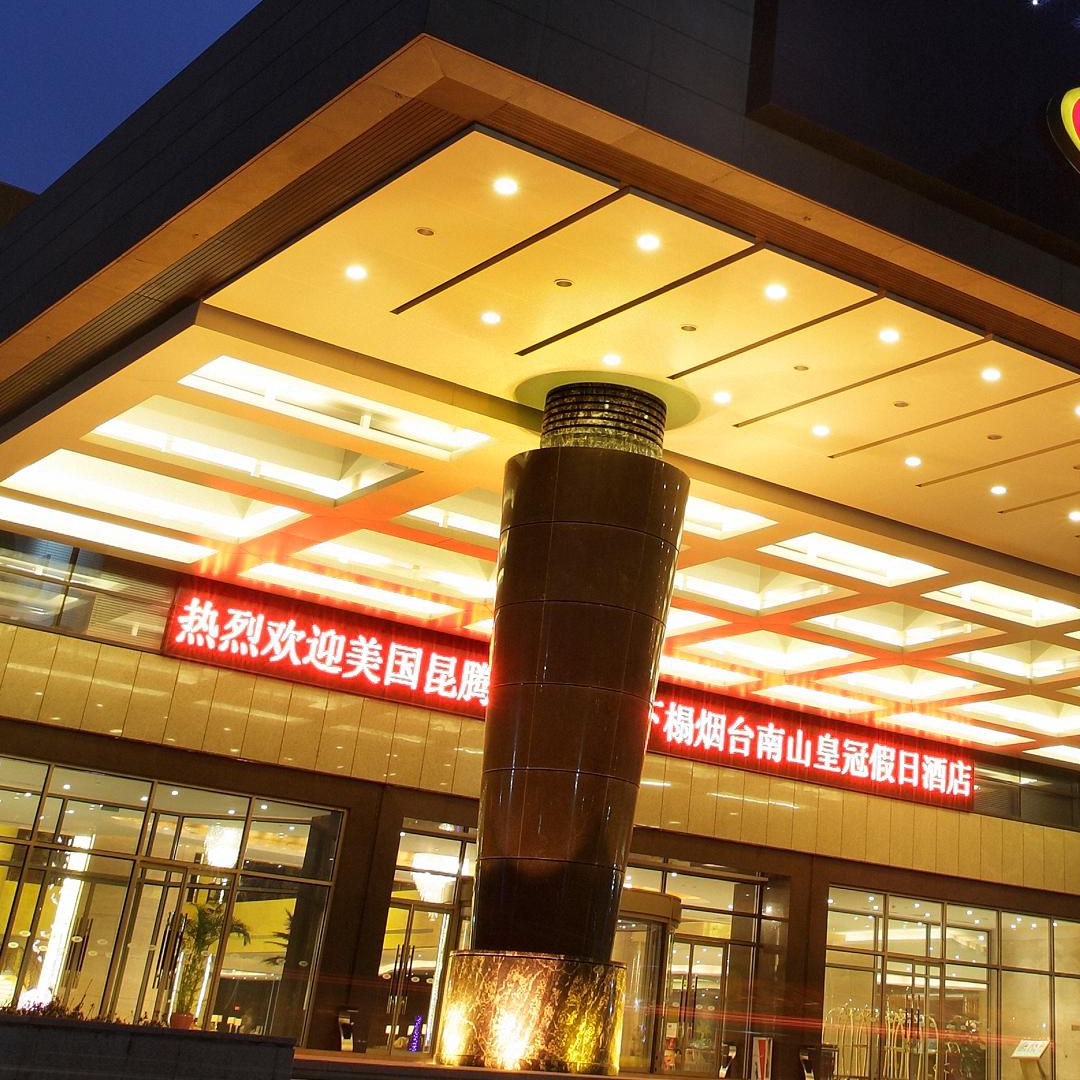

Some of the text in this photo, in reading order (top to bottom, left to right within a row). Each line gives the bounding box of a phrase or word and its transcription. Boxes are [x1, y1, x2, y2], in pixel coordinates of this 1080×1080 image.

[175, 597, 490, 706] 热烈欢迎美国昆腾
